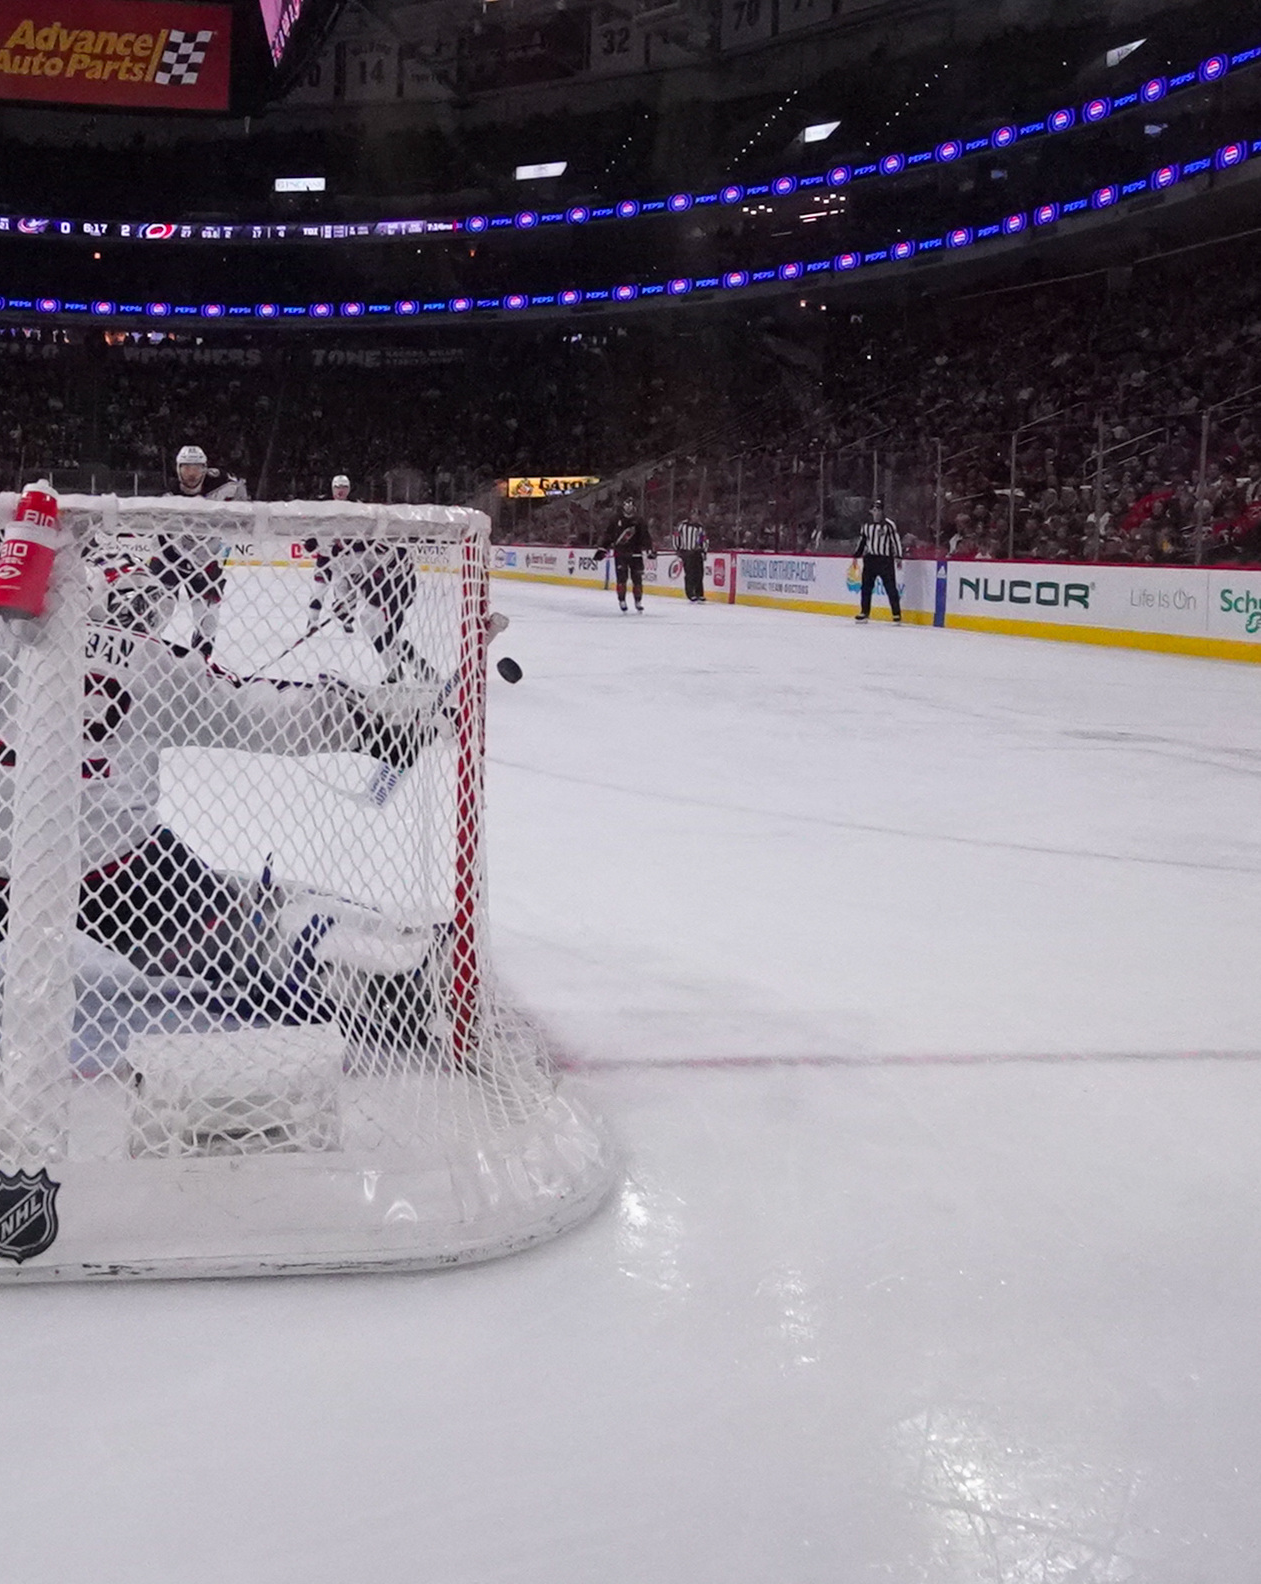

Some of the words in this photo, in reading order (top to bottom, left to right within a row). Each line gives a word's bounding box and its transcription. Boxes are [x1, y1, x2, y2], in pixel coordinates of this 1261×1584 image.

[4, 19, 154, 57] Advance
[601, 28, 628, 55] 32
[65, 53, 146, 80] Parts
[1232, 48, 1261, 64] PEPSI
[359, 60, 383, 84] 14
[1184, 158, 1210, 174] PEPSI
[61, 222, 70, 234] 0
[83, 223, 108, 234] 6:17
[121, 225, 130, 237] 2
[741, 558, 767, 580] RALEIGH
[769, 583, 782, 592] TEAM
[959, 577, 1090, 609] NUCOR
[1130, 587, 1155, 607] Life
[1158, 591, 1171, 608] Is
[1174, 590, 1196, 610] On
[1220, 588, 1261, 613] Sch
[1, 1195, 42, 1242] NHL
